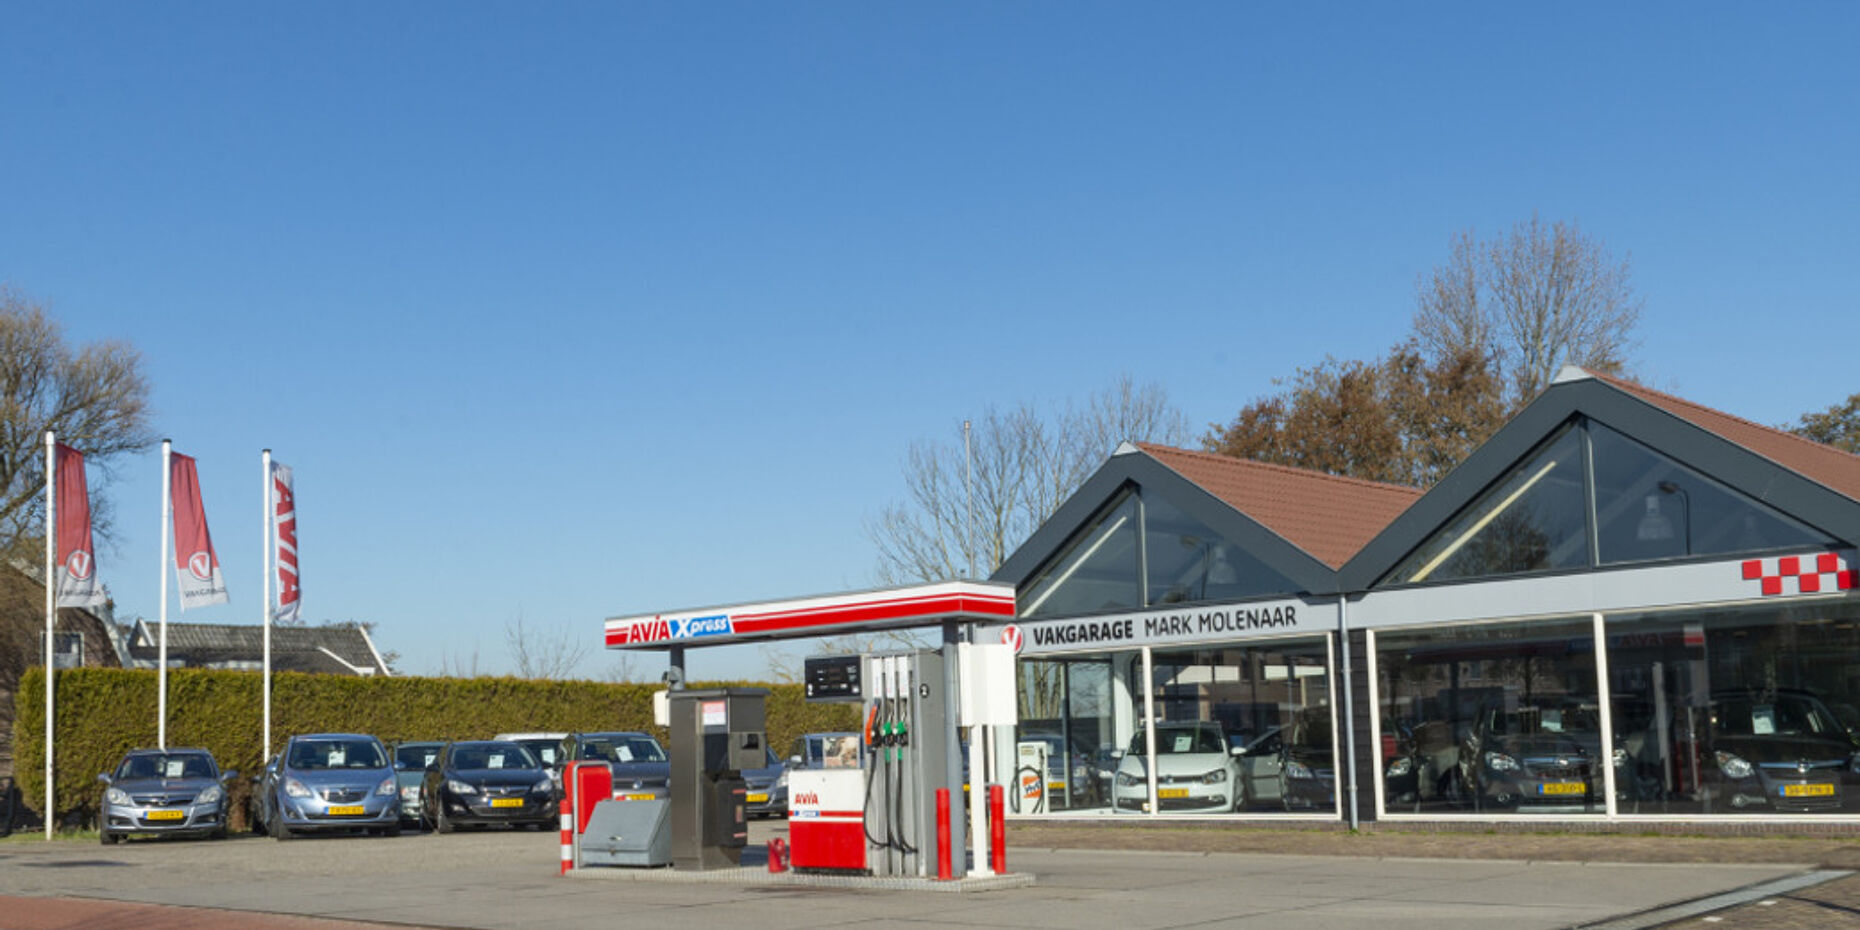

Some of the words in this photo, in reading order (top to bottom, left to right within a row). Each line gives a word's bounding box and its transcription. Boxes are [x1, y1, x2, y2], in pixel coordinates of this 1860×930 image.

[274, 477, 299, 606] AVIA
[630, 614, 670, 643] AVIA
[675, 617, 728, 638] Xpress
[1033, 619, 1134, 647] VAKGARAGE
[1144, 613, 1193, 637] MARK
[1199, 605, 1297, 634] MOLENAAR
[794, 790, 819, 804] AVIA
